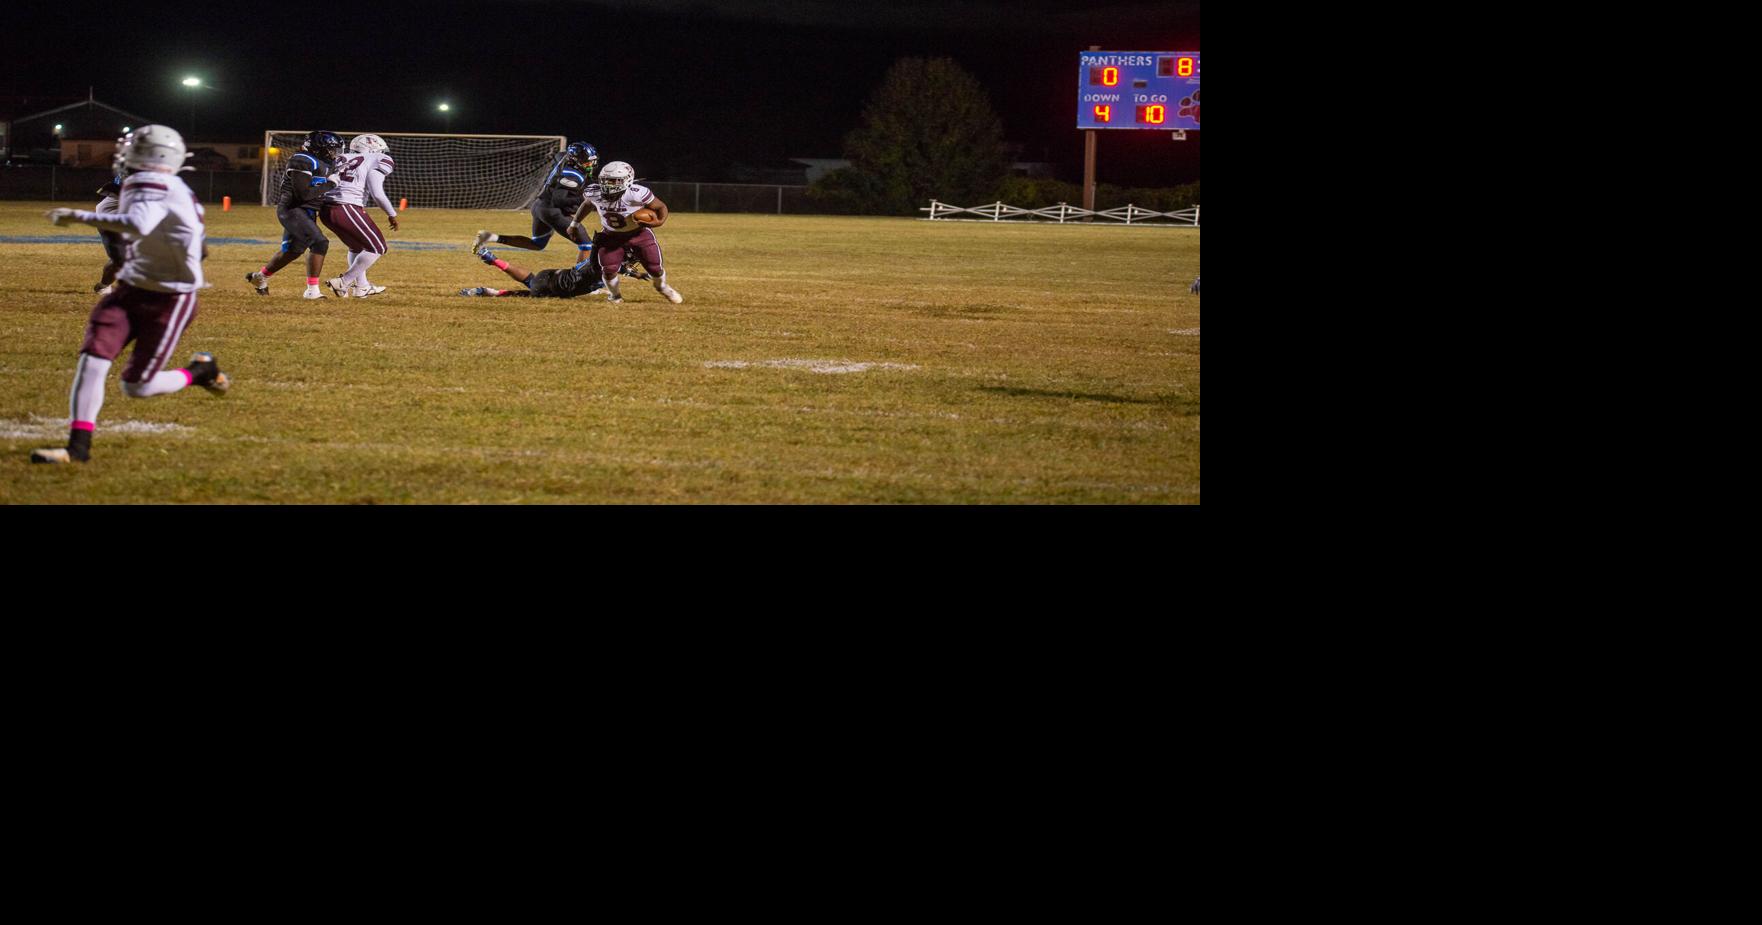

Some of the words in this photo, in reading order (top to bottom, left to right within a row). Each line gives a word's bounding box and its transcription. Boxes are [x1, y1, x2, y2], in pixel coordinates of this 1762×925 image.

[1081, 55, 1152, 66] PANTHERS
[1103, 67, 1118, 86] 0
[1084, 94, 1120, 102] DOWN
[1134, 94, 1148, 103] TO
[1150, 94, 1168, 103] GO
[1095, 105, 1110, 122] 4
[1145, 105, 1165, 124] 10
[603, 213, 627, 229] 8
